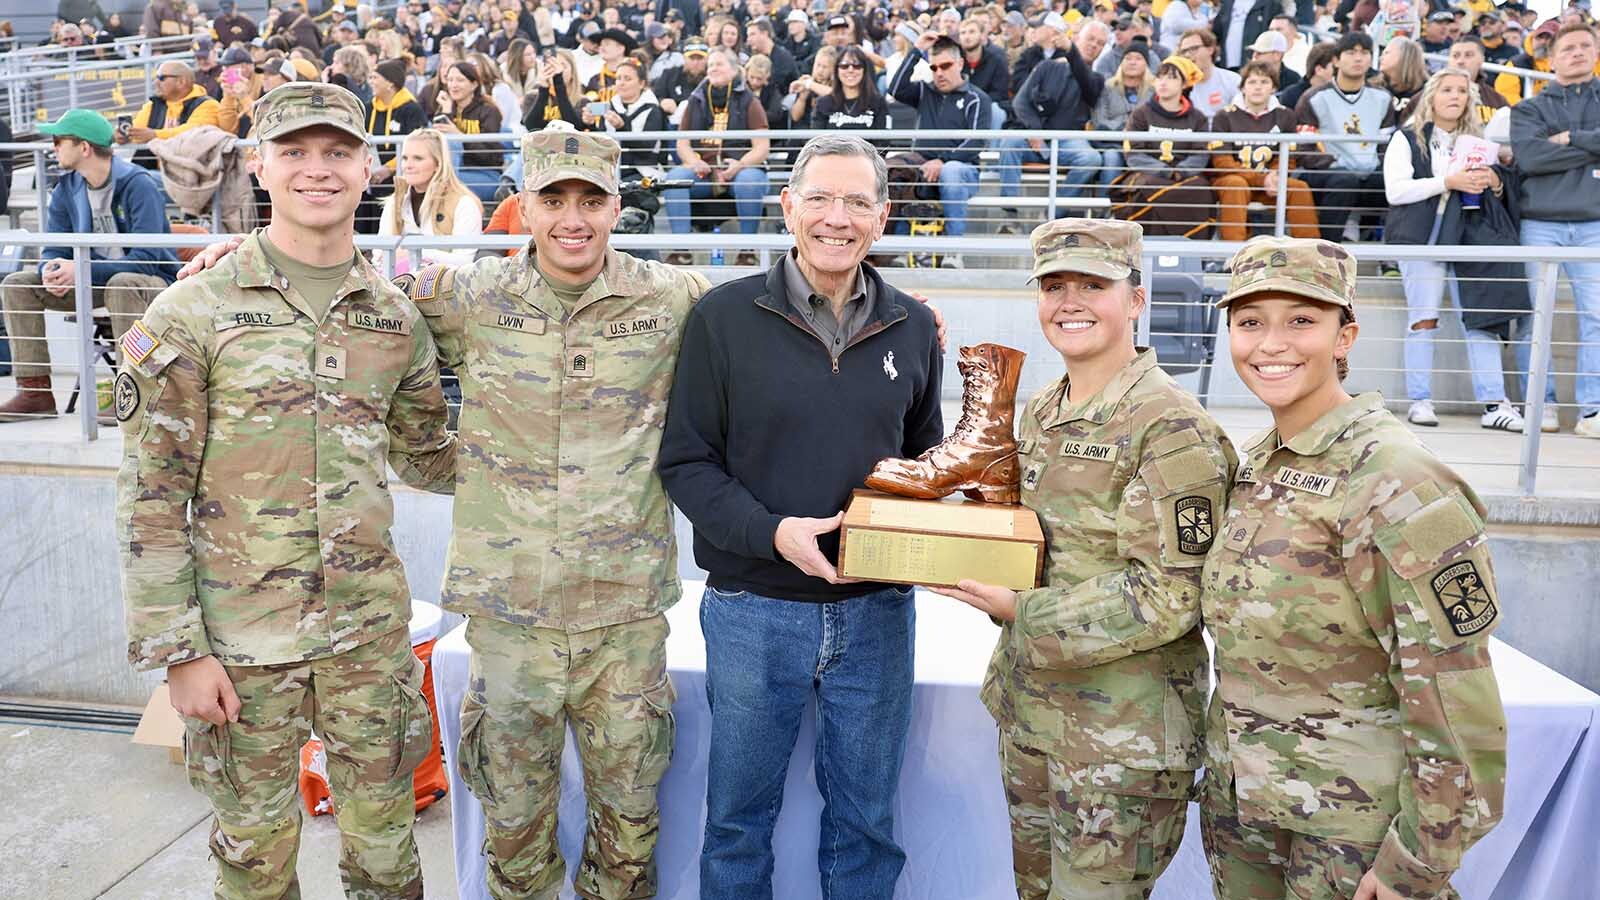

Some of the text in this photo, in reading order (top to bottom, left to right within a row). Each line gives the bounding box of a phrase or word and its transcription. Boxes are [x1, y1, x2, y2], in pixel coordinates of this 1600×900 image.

[235, 312, 273, 325] FOLTZ
[355, 313, 403, 331] U.S. ARMY
[497, 314, 525, 329] LWIN
[610, 317, 658, 335] U.S. ARMY
[1064, 442, 1111, 459] U.S. ARMY
[1435, 564, 1472, 590] LEADERSHIP
[1458, 606, 1495, 632] EXCELLENCE
